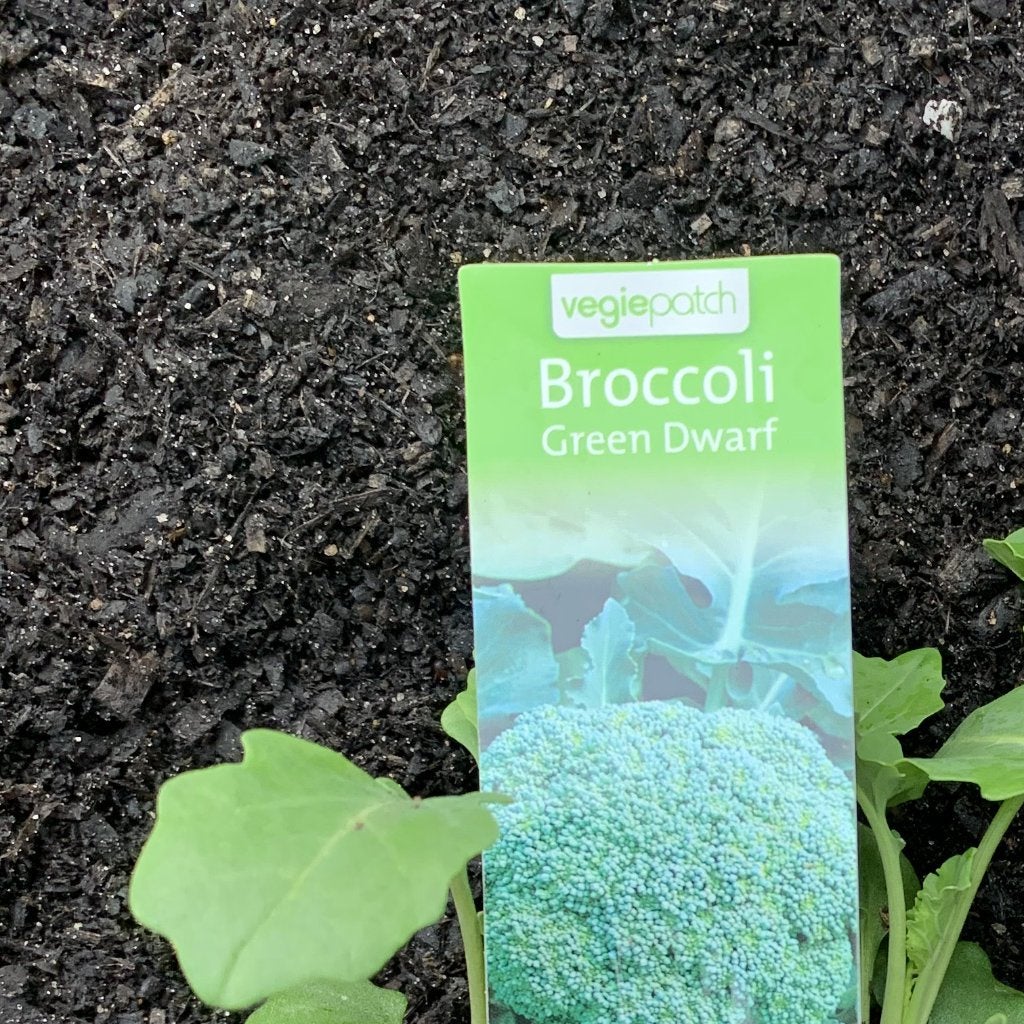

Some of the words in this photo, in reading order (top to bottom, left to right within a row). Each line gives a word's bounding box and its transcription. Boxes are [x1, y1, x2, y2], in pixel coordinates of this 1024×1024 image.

[561, 280, 737, 328] vegiepatch
[539, 348, 775, 409] Broccoli
[542, 424, 651, 457] Green
[664, 417, 778, 454] Dwarf
